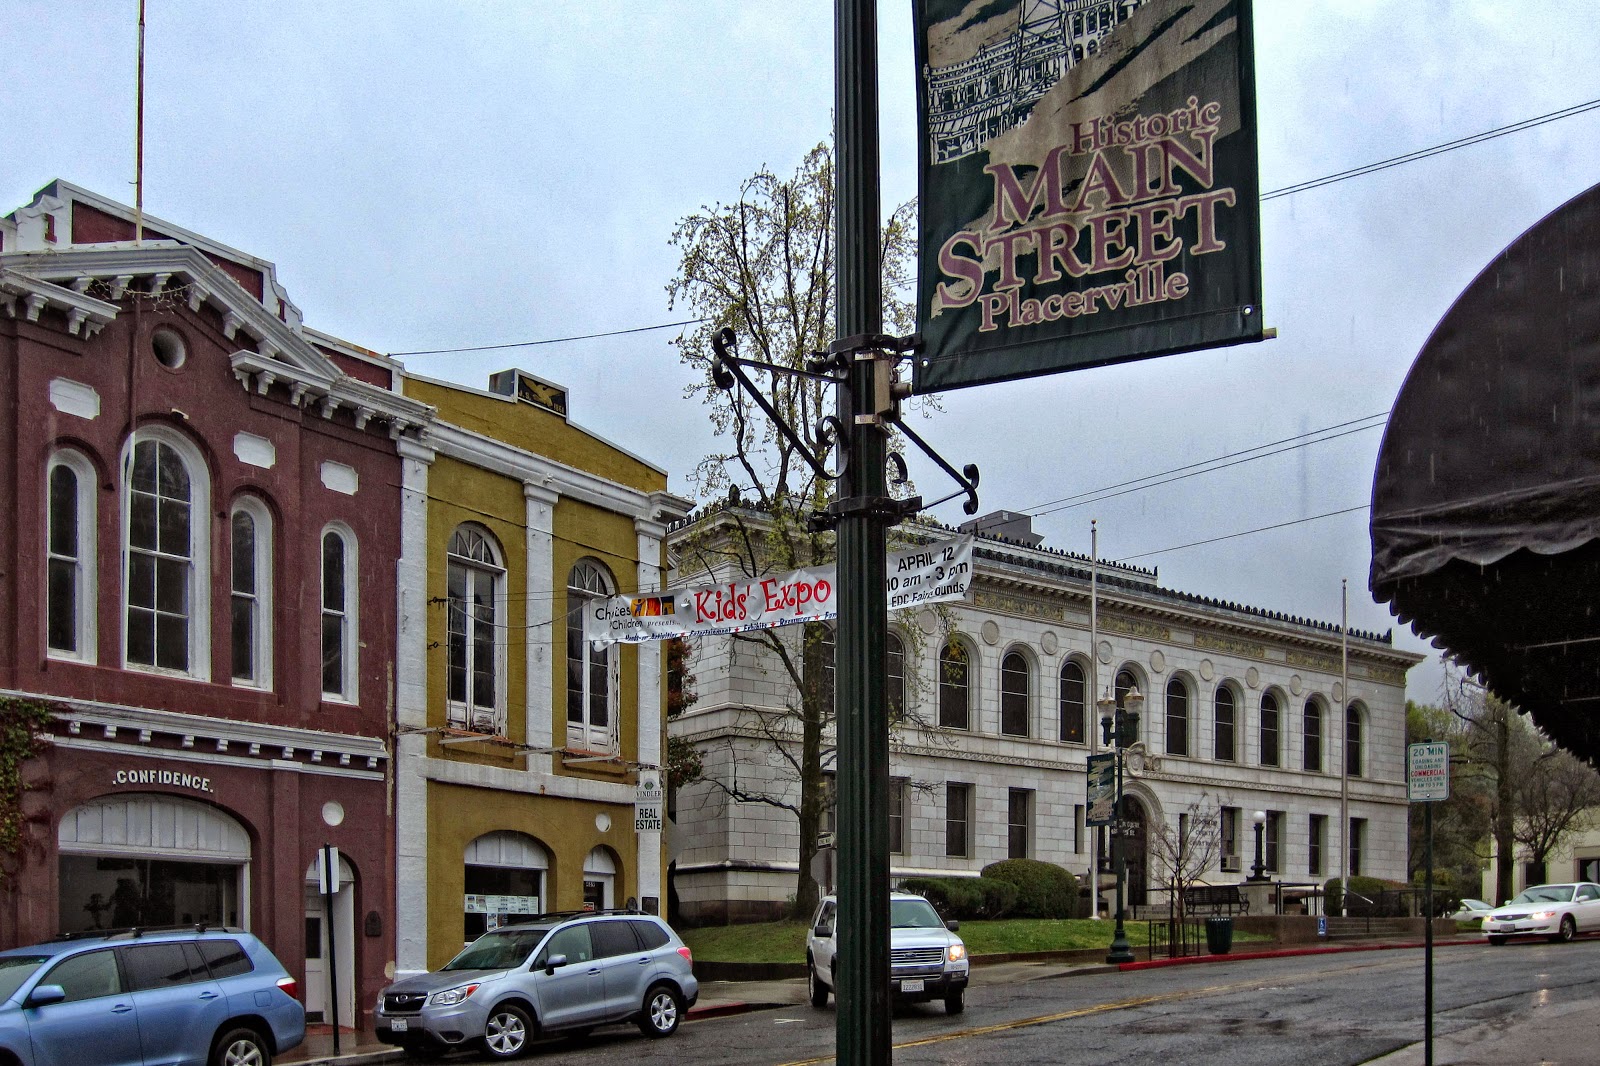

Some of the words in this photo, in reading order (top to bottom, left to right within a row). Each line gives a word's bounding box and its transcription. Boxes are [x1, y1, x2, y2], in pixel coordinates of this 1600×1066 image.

[1069, 95, 1221, 155] Historic
[982, 127, 1218, 233] MAIN
[936, 187, 1237, 308] STREET
[977, 262, 1190, 333] Placerville
[897, 551, 937, 573] APRIL
[941, 546, 955, 562] 12
[902, 574, 921, 588] am
[934, 565, 945, 581] 3
[947, 561, 968, 580] pm
[694, 583, 750, 623] Kids'
[760, 577, 832, 616] Expo
[1428, 747, 1443, 756] MIN
[1411, 769, 1445, 777] COMMERCIAL
[635, 819, 661, 830] ESTATE
[639, 808, 658, 819] REAL
